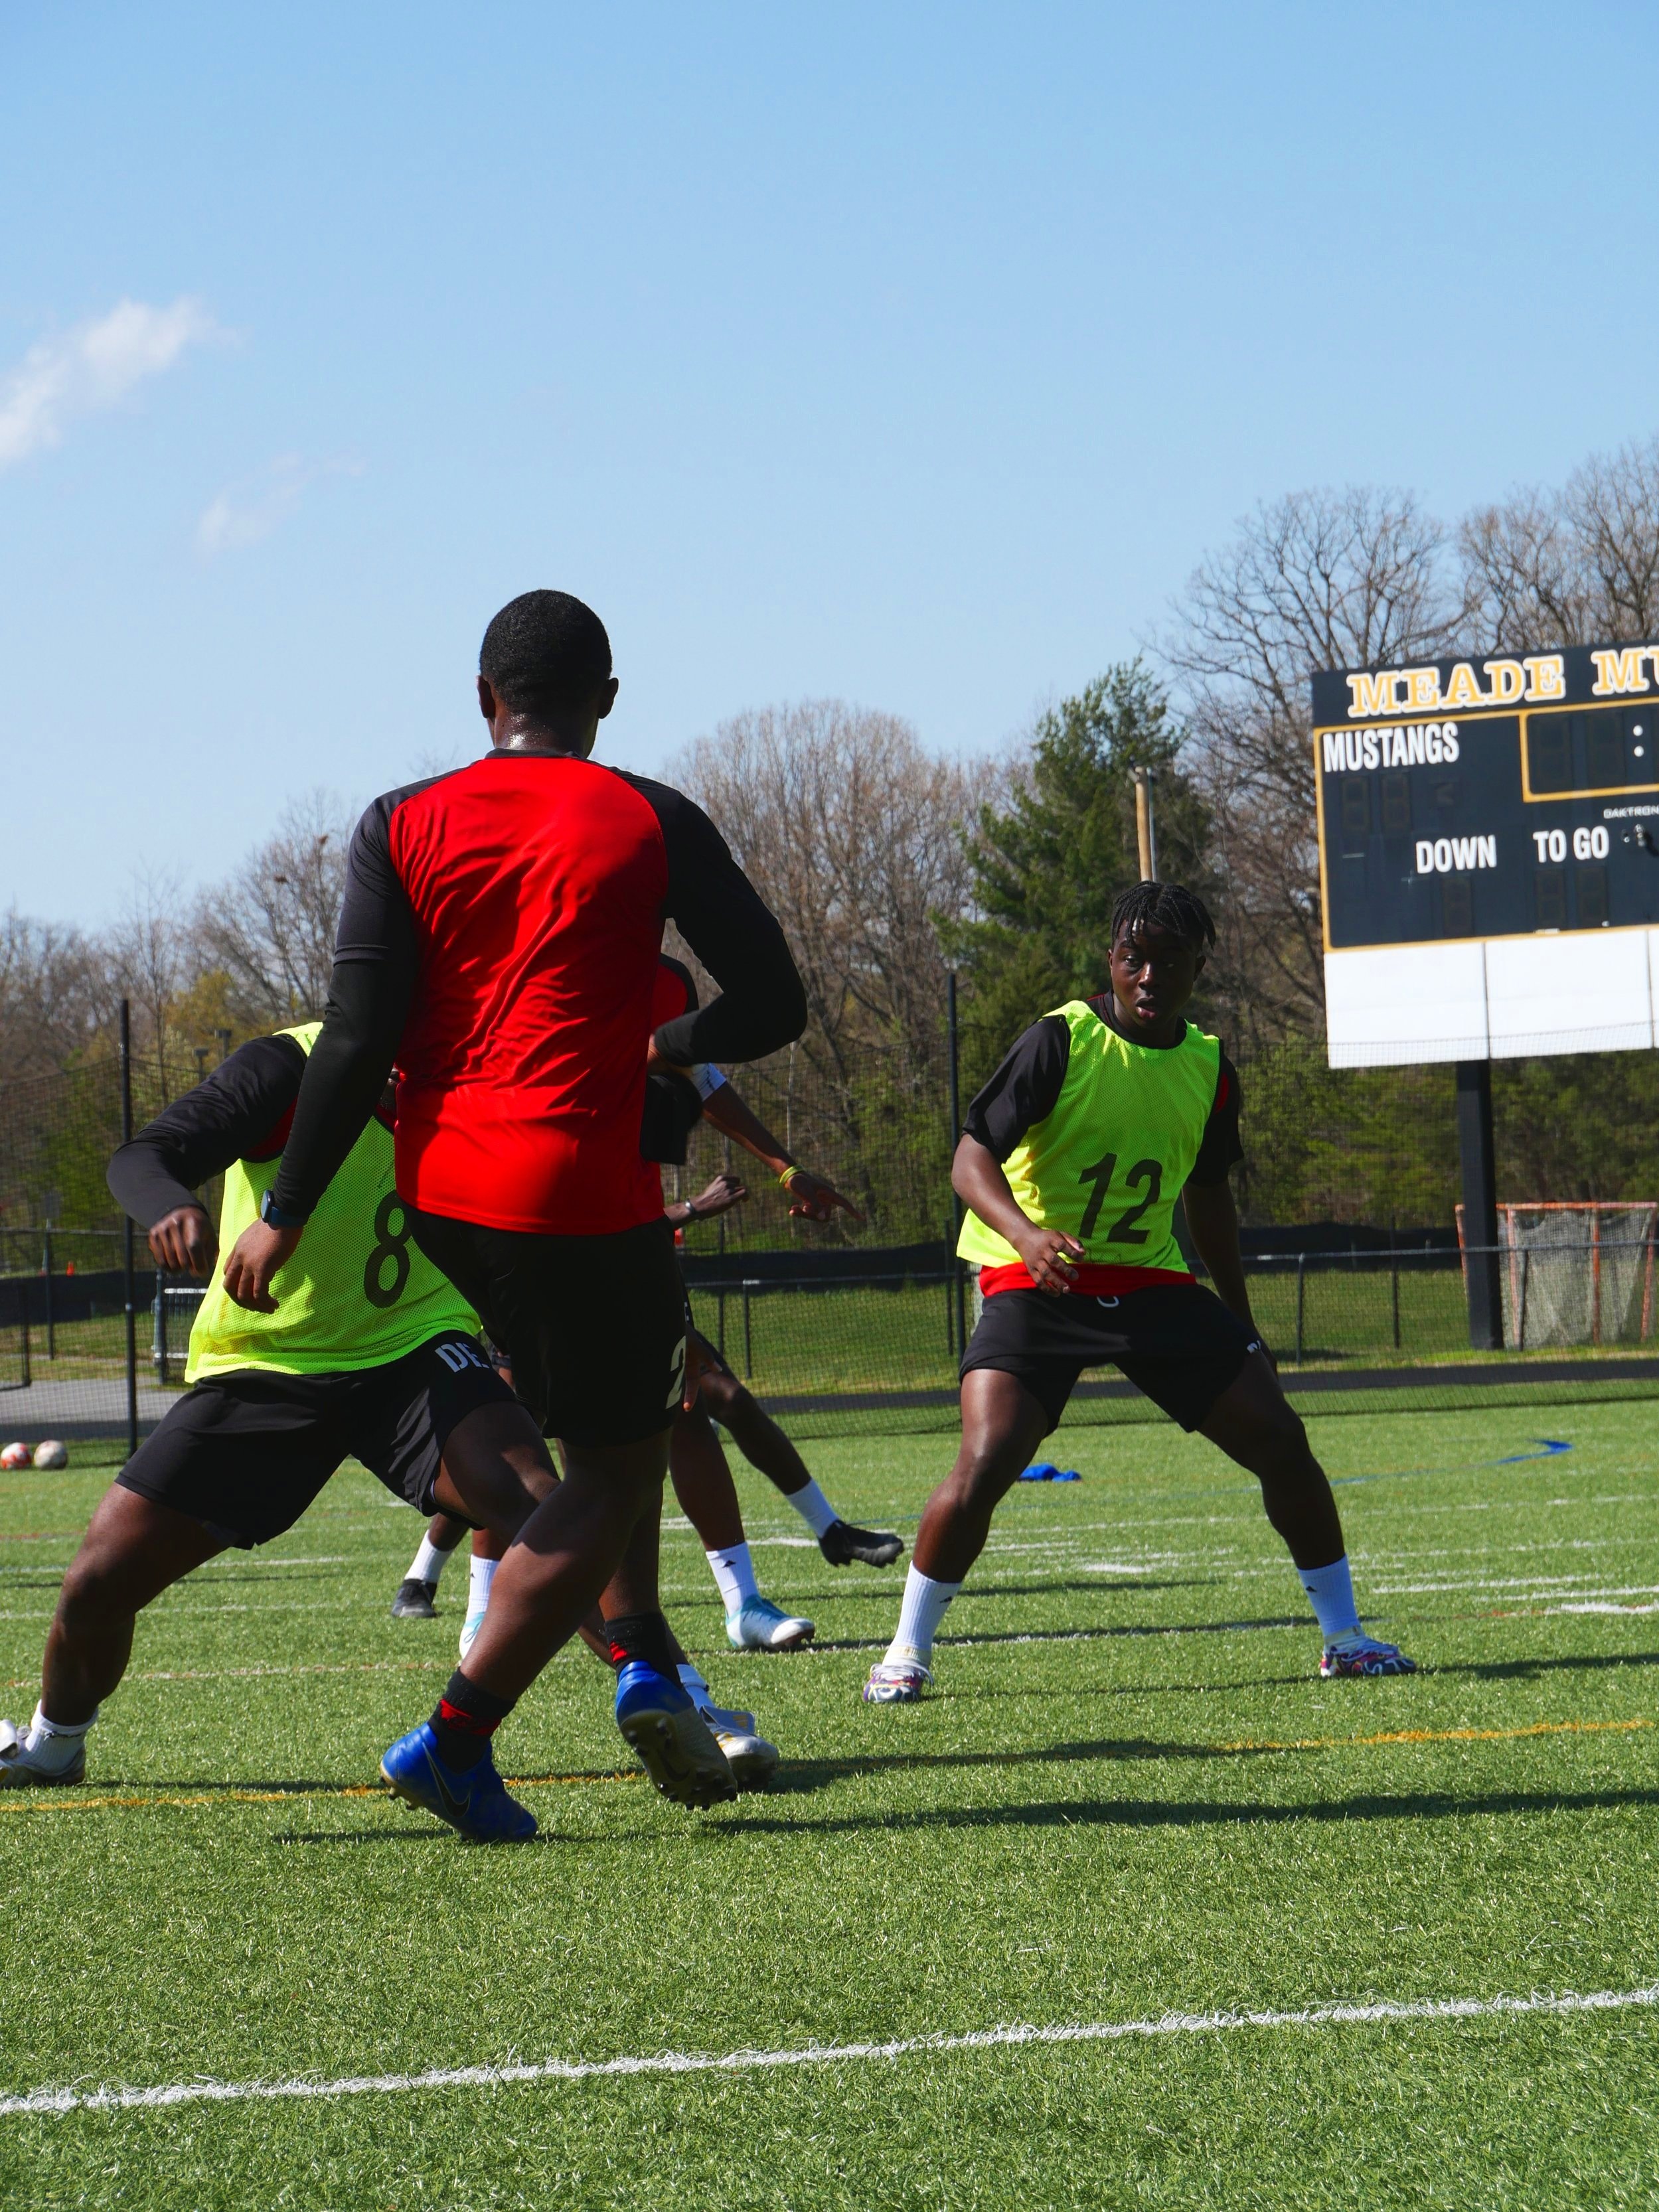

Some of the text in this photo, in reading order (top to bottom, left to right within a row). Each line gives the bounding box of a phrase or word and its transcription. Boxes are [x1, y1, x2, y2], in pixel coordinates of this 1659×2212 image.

[1346, 645, 1659, 717] MEADE M
[1323, 721, 1460, 773] MUSTANGS
[1415, 834, 1497, 874] DOWN
[1532, 826, 1609, 863] TO GO
[1078, 1152, 1163, 1244] 12
[364, 1189, 412, 1309] 8
